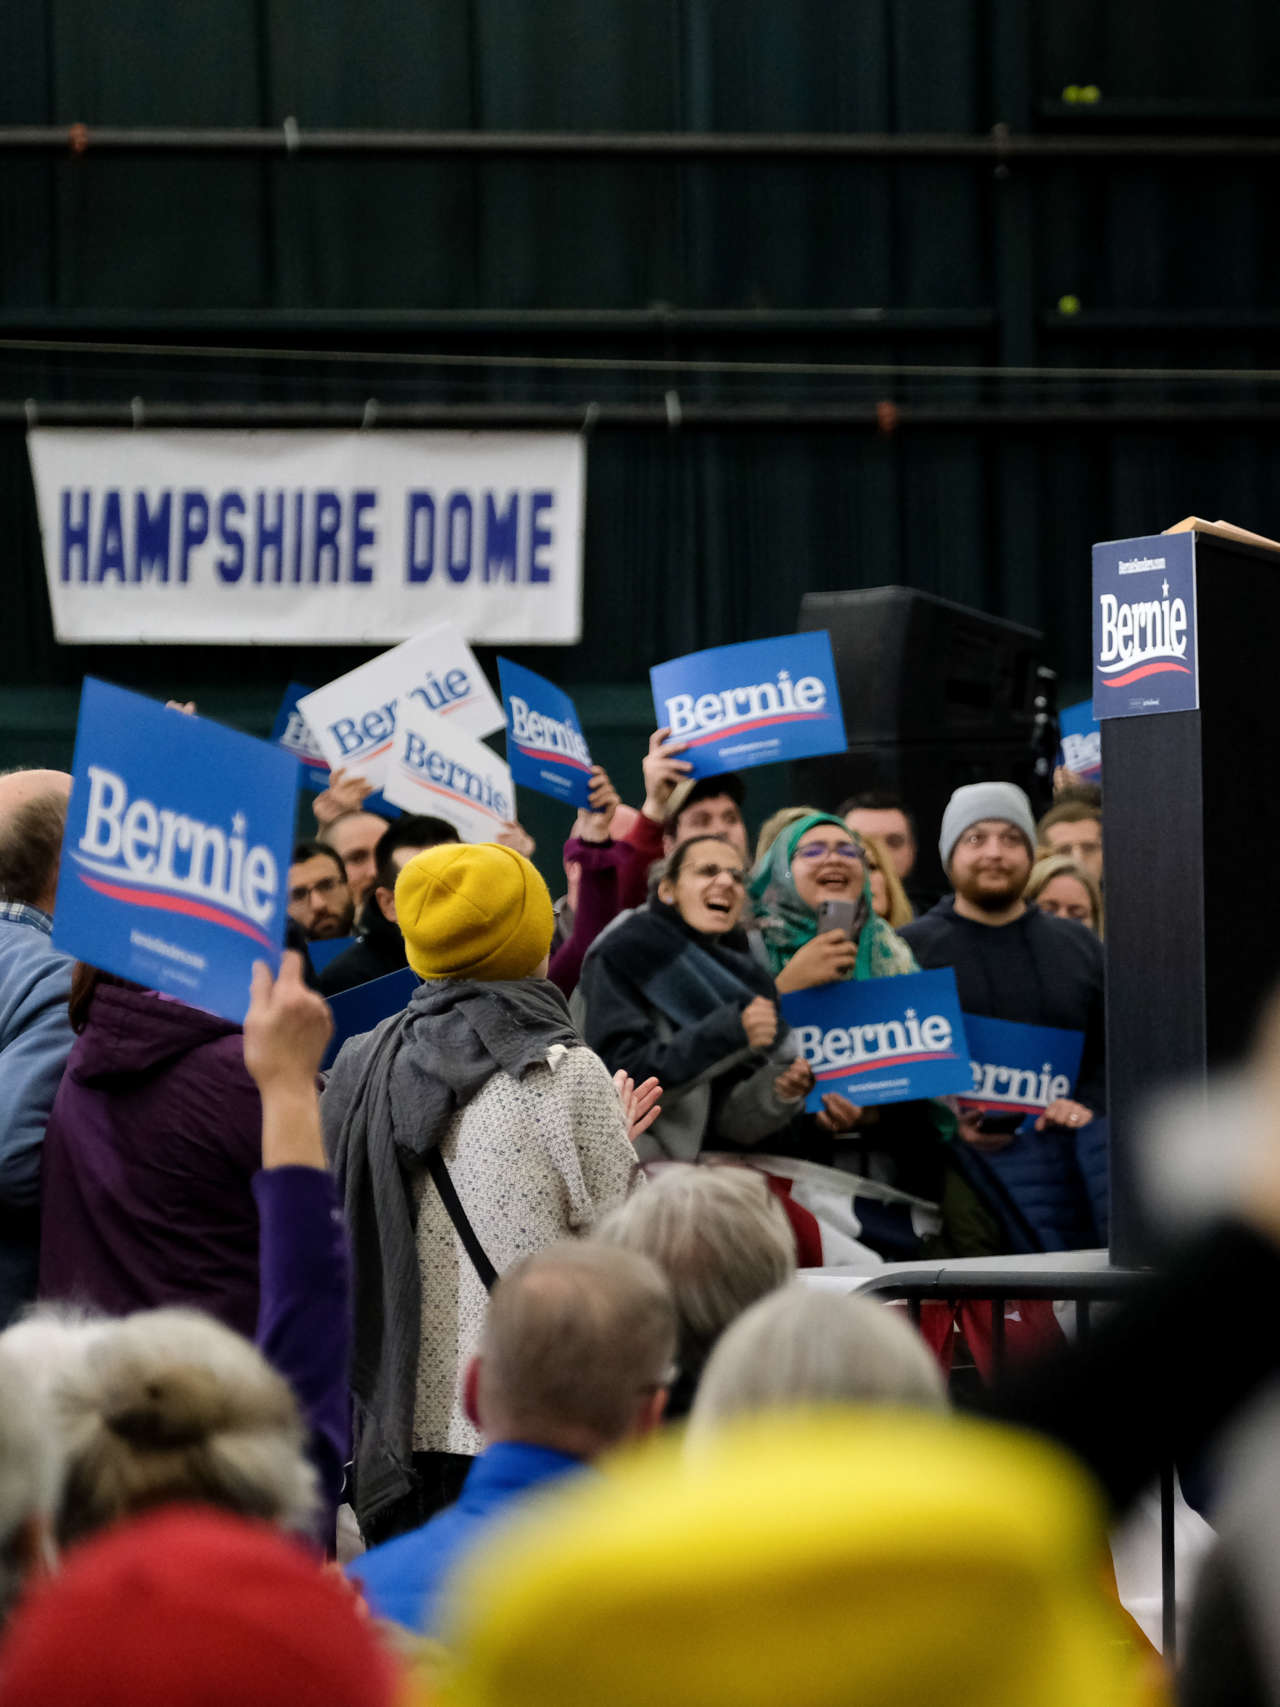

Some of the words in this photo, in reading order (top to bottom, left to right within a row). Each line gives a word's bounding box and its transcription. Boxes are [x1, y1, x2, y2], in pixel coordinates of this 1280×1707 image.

[60, 487, 377, 584] HAMPSHIRE
[405, 487, 556, 584] DOME
[1100, 577, 1188, 661] Bernie
[665, 668, 827, 736] Bernie
[404, 730, 508, 814] Bernie
[79, 765, 278, 926] Bernie
[795, 1008, 953, 1065] Bernie
